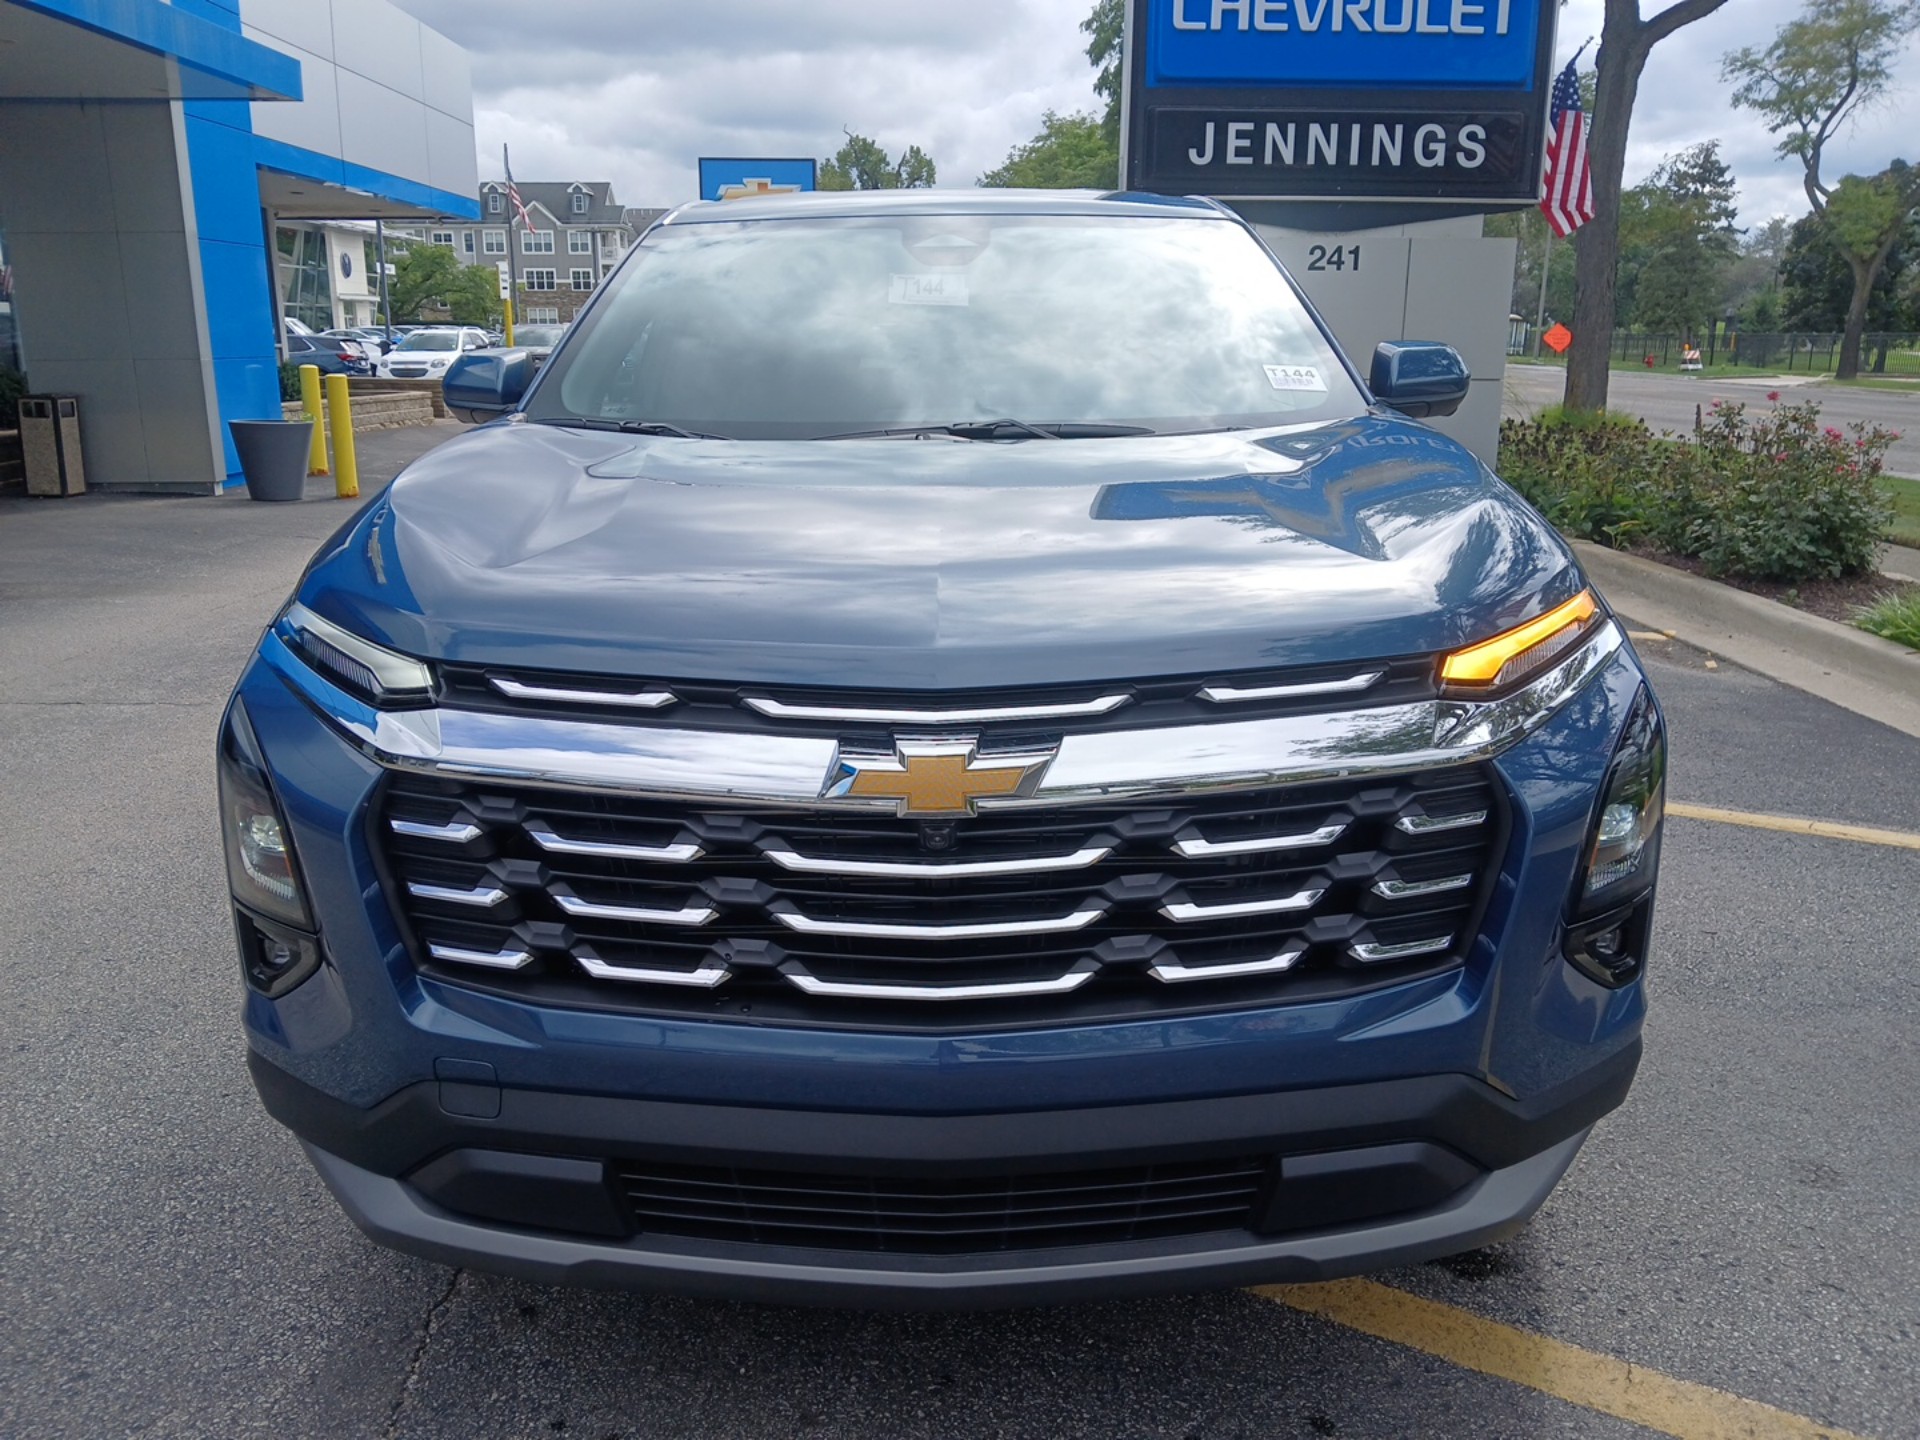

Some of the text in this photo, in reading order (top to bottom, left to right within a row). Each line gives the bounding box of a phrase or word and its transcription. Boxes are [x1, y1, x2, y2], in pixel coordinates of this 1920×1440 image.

[1188, 122, 1487, 168] JENNINGS
[1307, 244, 1360, 271] 241
[1267, 368, 1315, 378] T144
